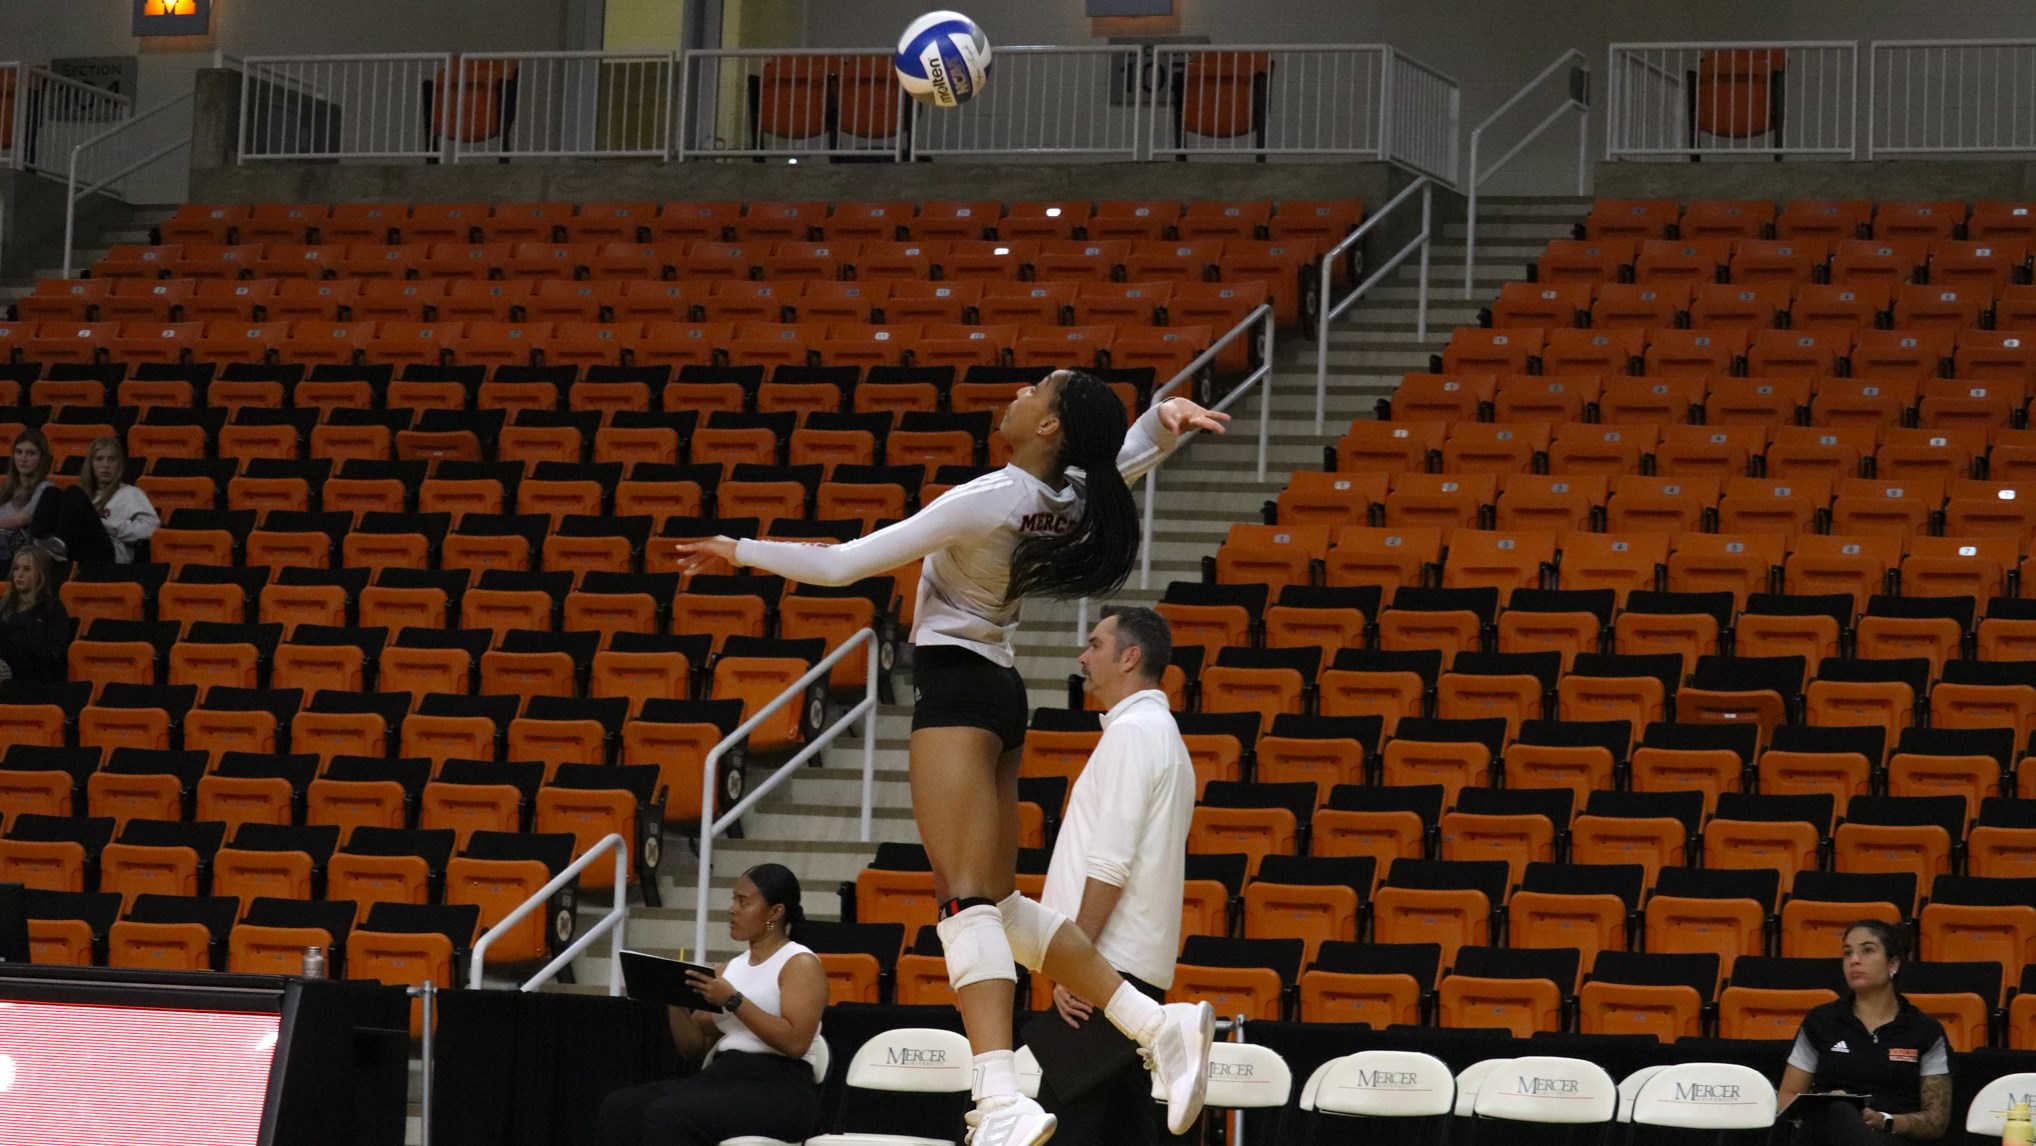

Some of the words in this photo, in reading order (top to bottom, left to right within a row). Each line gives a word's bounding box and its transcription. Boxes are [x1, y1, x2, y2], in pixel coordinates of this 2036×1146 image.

[63, 63, 122, 77] SECTION
[930, 58, 952, 104] molten
[887, 1047, 946, 1064] MERCER
[1357, 1069, 1418, 1087] MERCER
[1517, 1076, 1579, 1094] MERCER
[1675, 1082, 1740, 1101] MERCER
